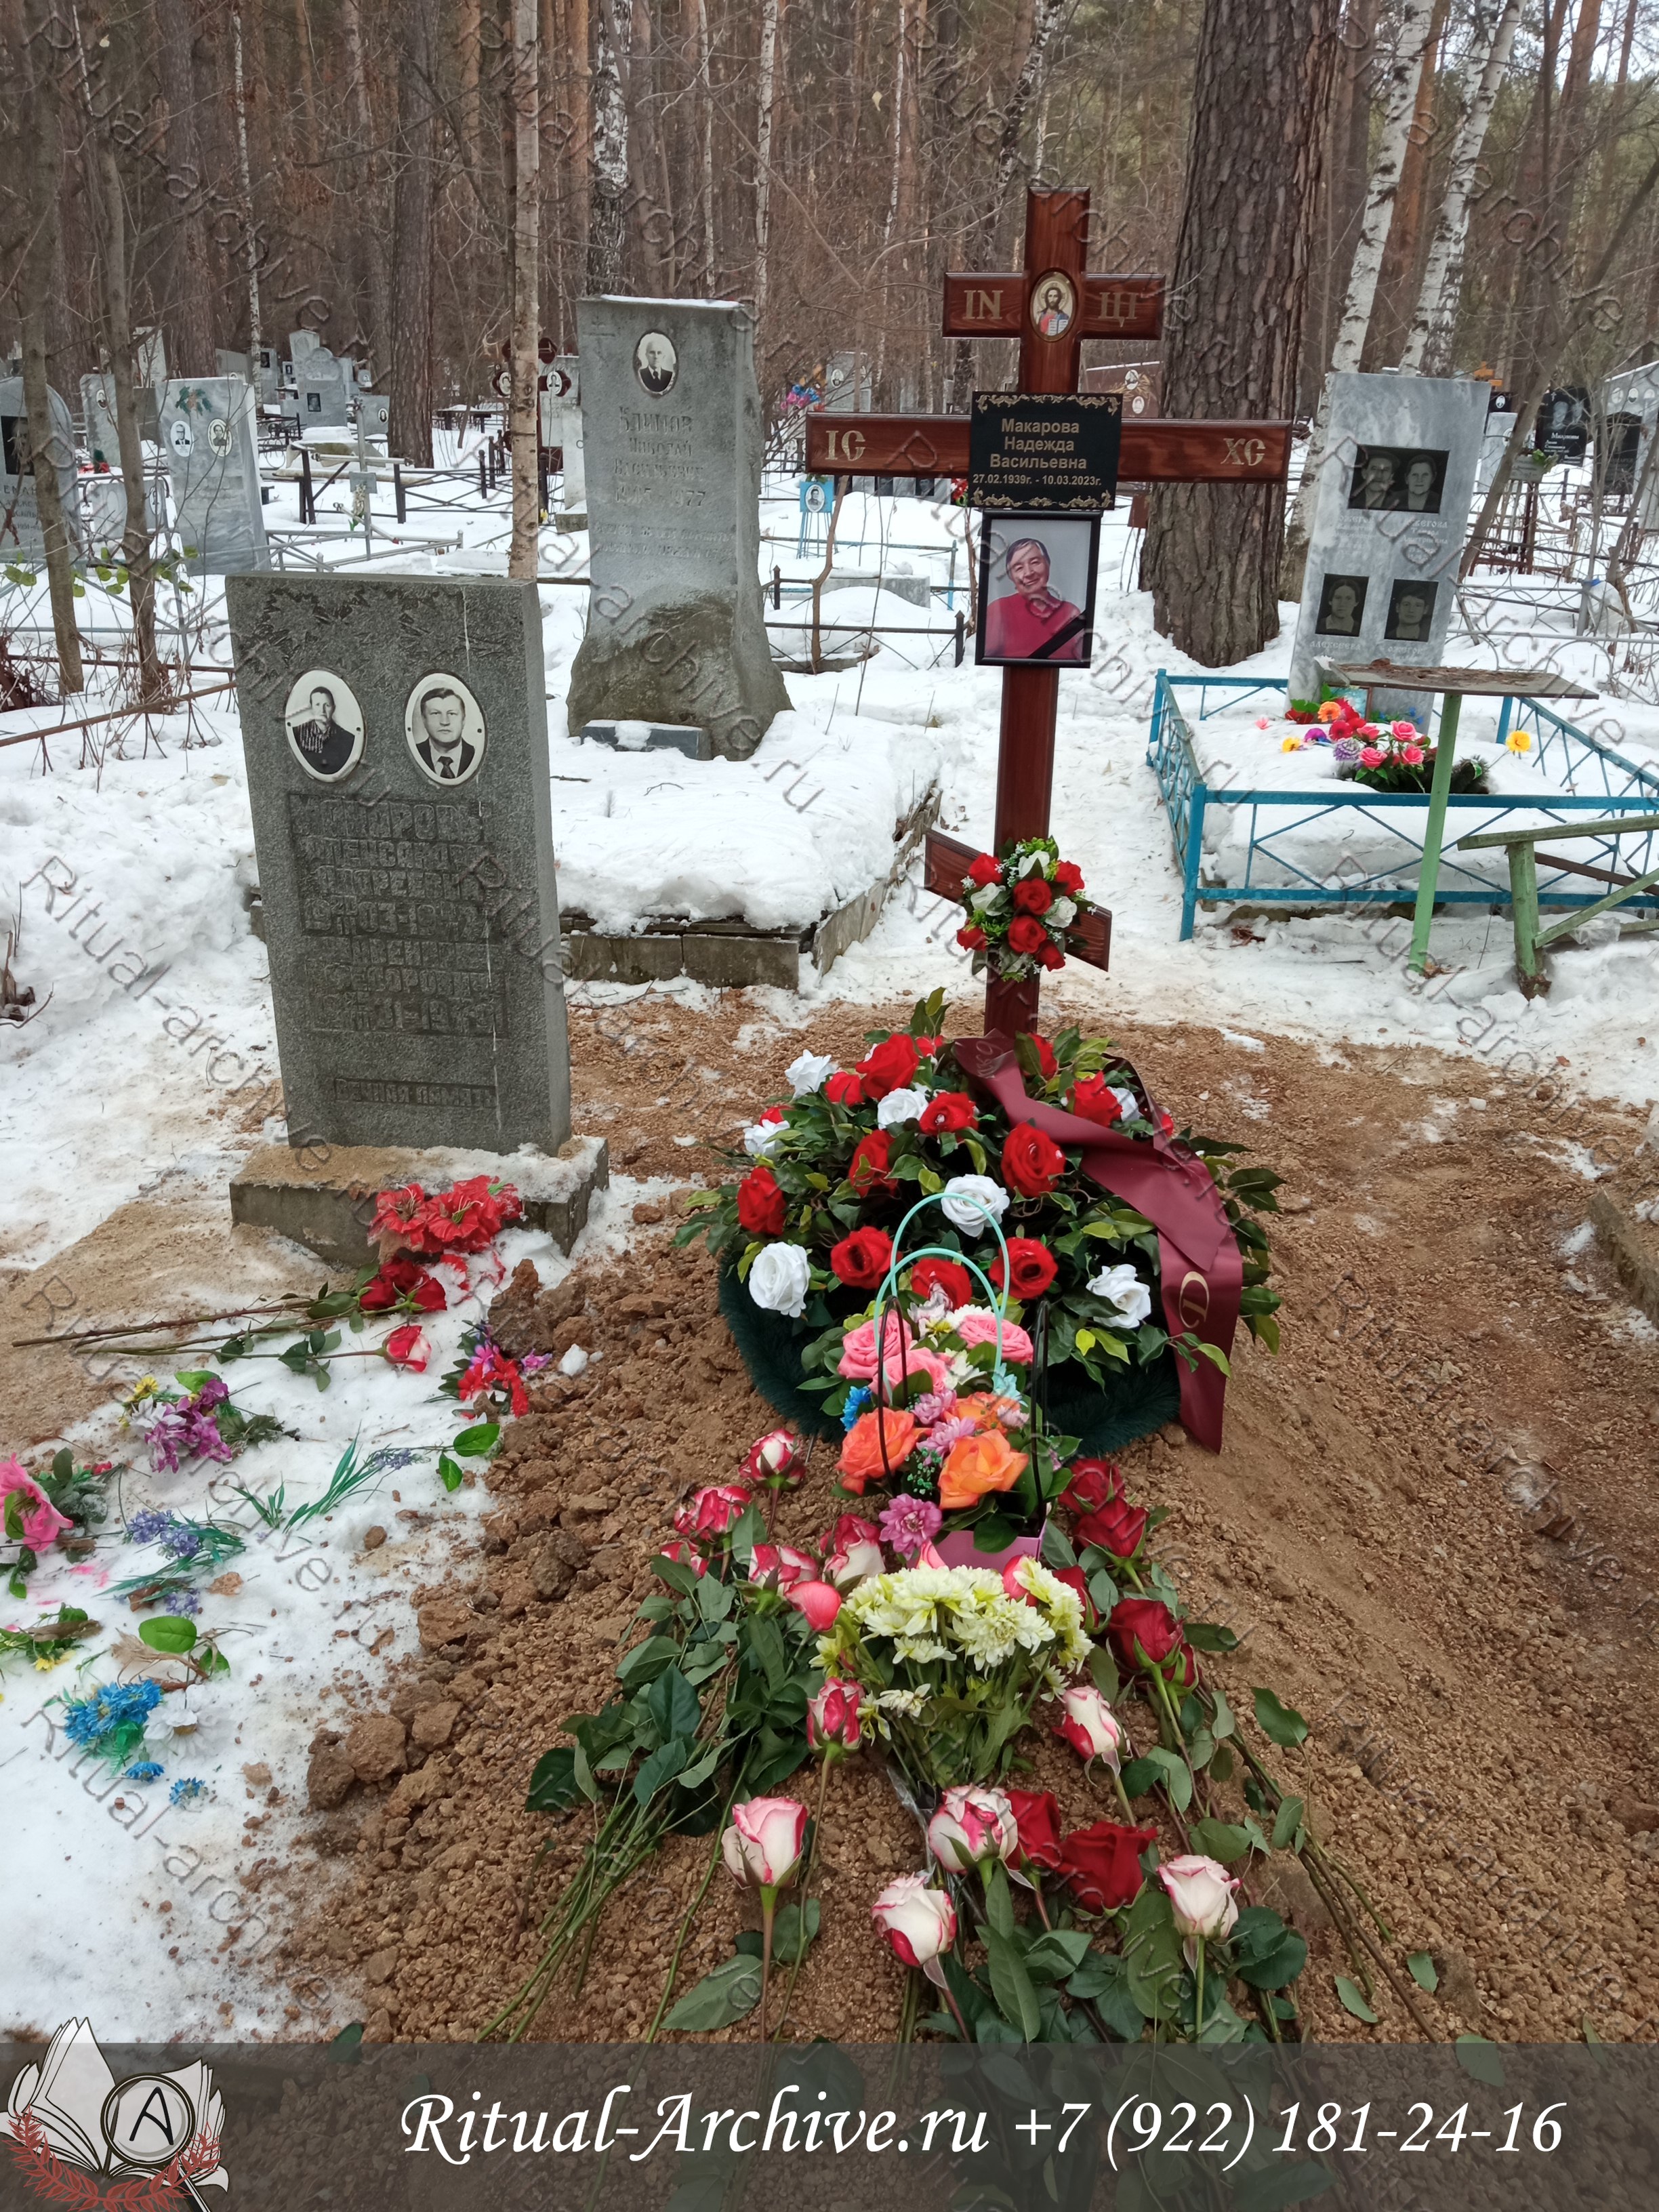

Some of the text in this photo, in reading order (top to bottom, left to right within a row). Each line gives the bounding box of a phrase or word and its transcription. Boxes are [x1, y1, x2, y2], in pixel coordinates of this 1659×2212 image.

[1001, 417, 1080, 436] Макарова
[1004, 436, 1075, 453] Надежда
[989, 453, 1087, 470] Васильевна
[972, 473, 1033, 485] 27.02.1939г.
[1042, 474, 1102, 487] 10.03.2023г.
